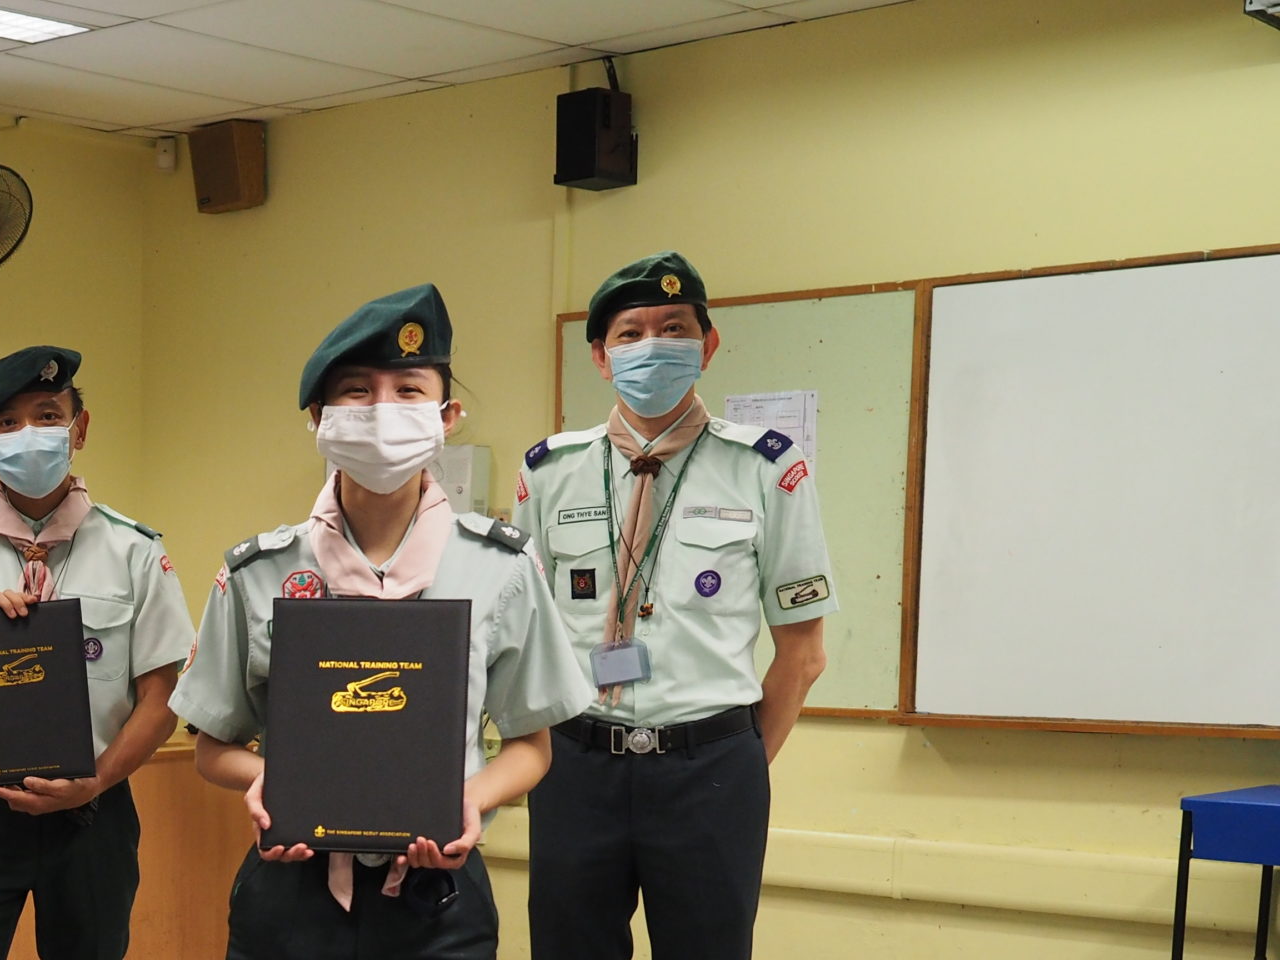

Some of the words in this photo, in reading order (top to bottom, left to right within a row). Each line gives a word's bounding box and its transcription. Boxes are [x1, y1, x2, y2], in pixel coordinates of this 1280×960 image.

[562, 512, 576, 520] ONG
[576, 511, 593, 519] THYE
[9, 647, 36, 655] TRAINING
[319, 661, 359, 669] NATIONAL
[360, 661, 398, 669] TRAINING
[399, 662, 422, 670] TEAM
